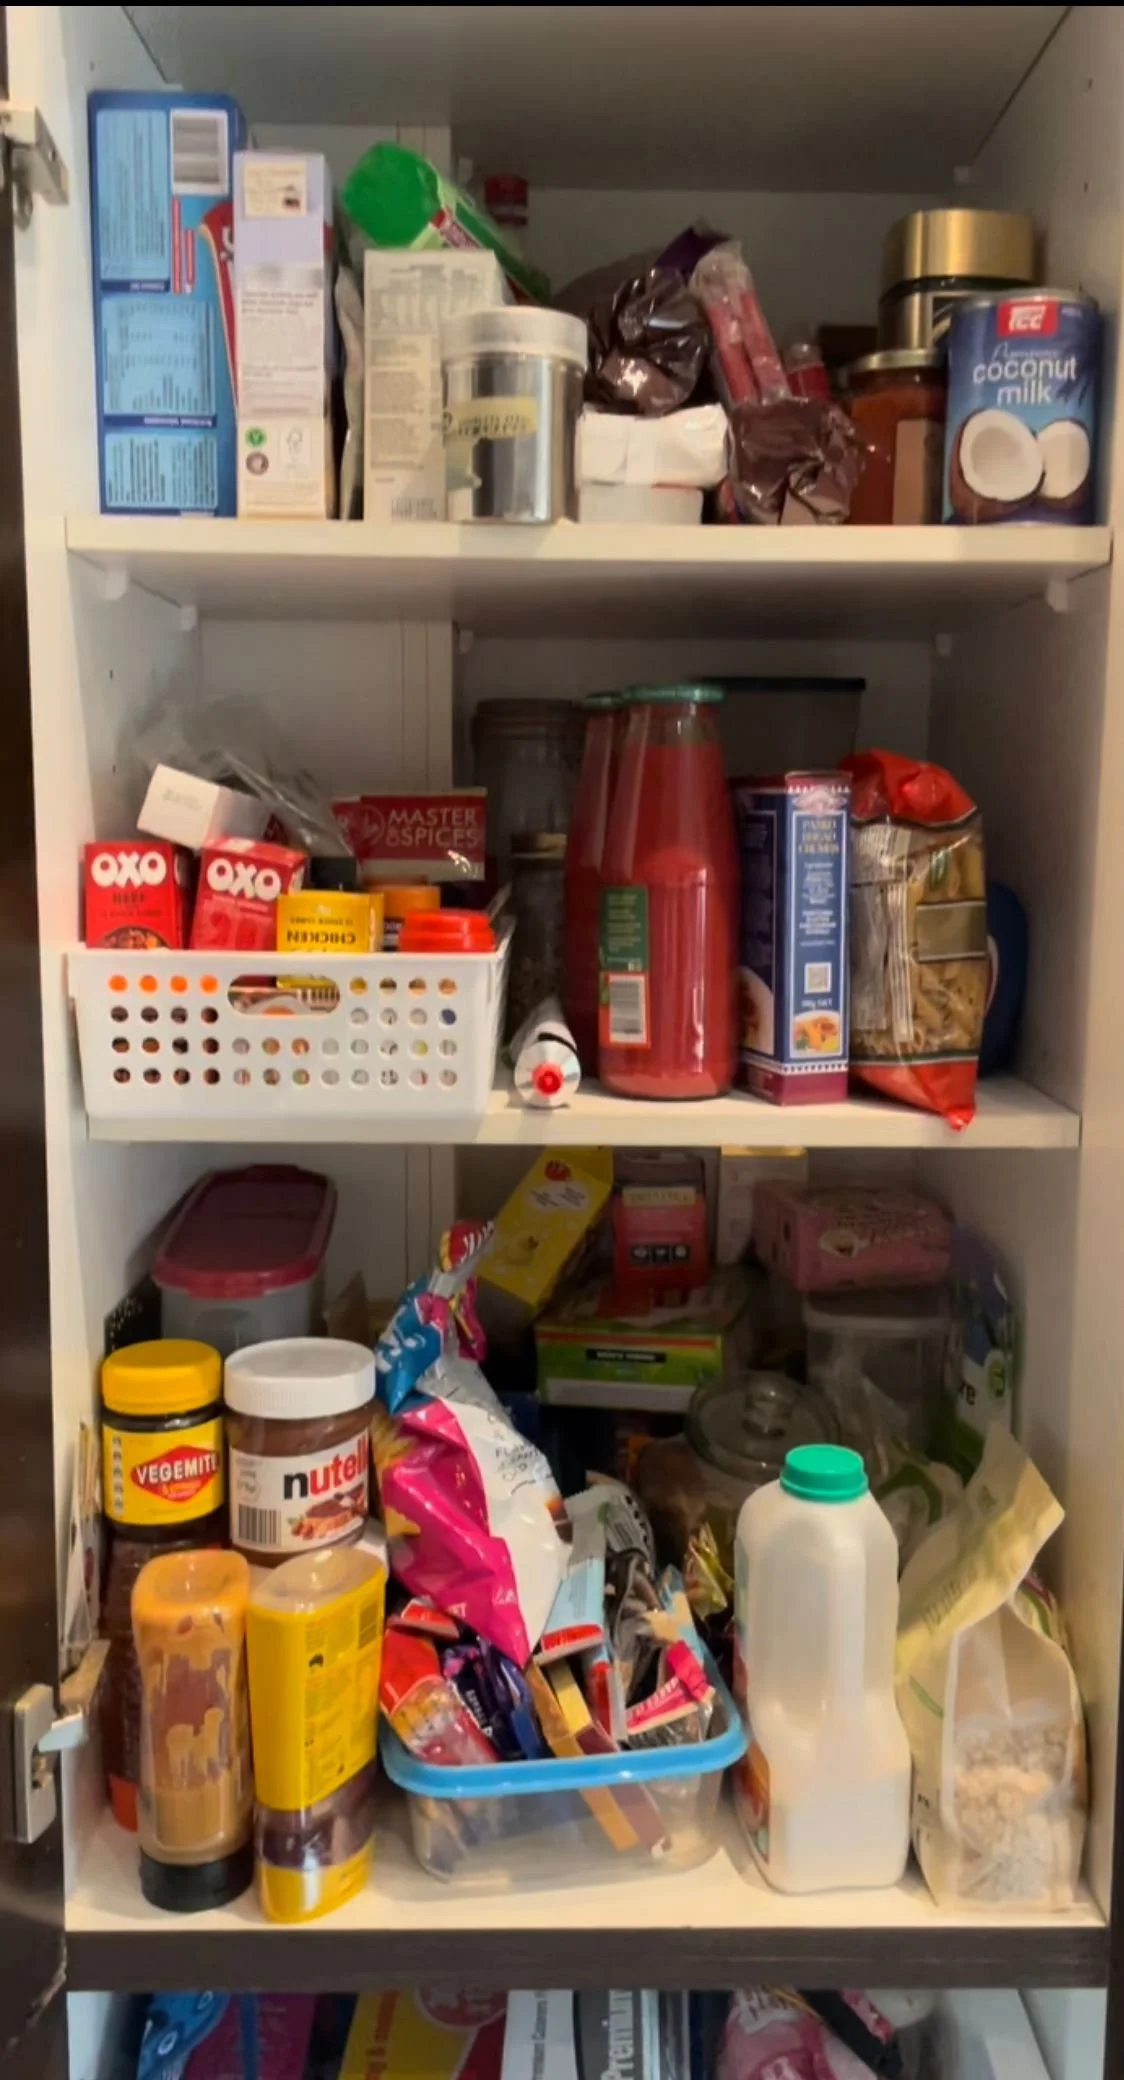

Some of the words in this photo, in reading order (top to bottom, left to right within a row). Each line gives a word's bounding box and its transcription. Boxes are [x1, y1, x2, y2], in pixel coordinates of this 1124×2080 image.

[972, 355, 1077, 385] coconut
[997, 378, 1052, 406] milk
[388, 806, 479, 827] MASTER
[91, 850, 167, 889] OXO
[206, 857, 281, 901] OXO
[286, 929, 356, 945] CHICKEN
[283, 1434, 368, 1500] nutell
